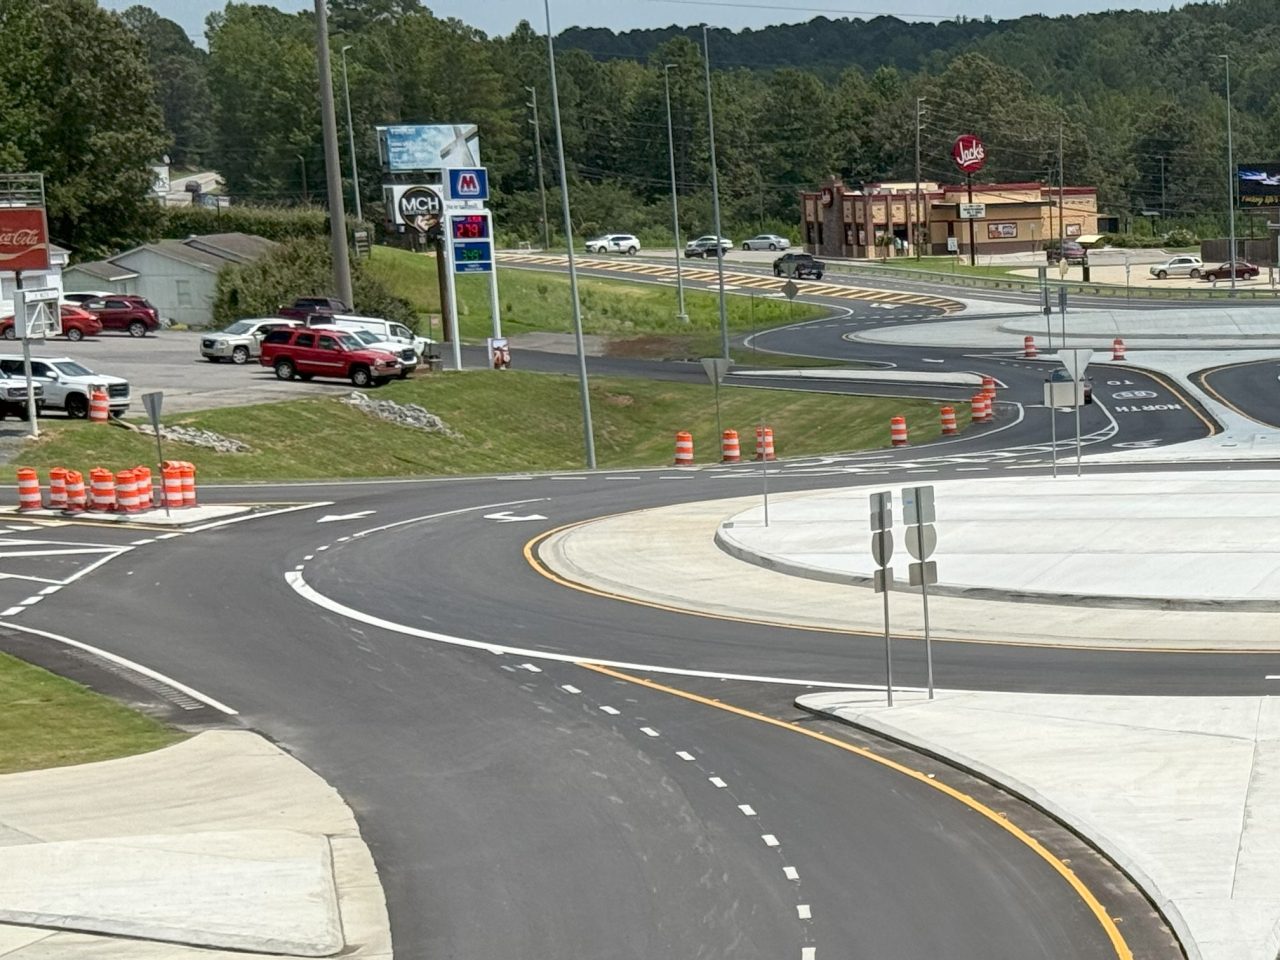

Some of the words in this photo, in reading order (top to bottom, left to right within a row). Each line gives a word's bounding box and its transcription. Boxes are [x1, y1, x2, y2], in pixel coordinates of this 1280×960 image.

[956, 140, 984, 165] Jack's
[402, 197, 439, 211] MCH
[1115, 403, 1182, 412] NORTH
